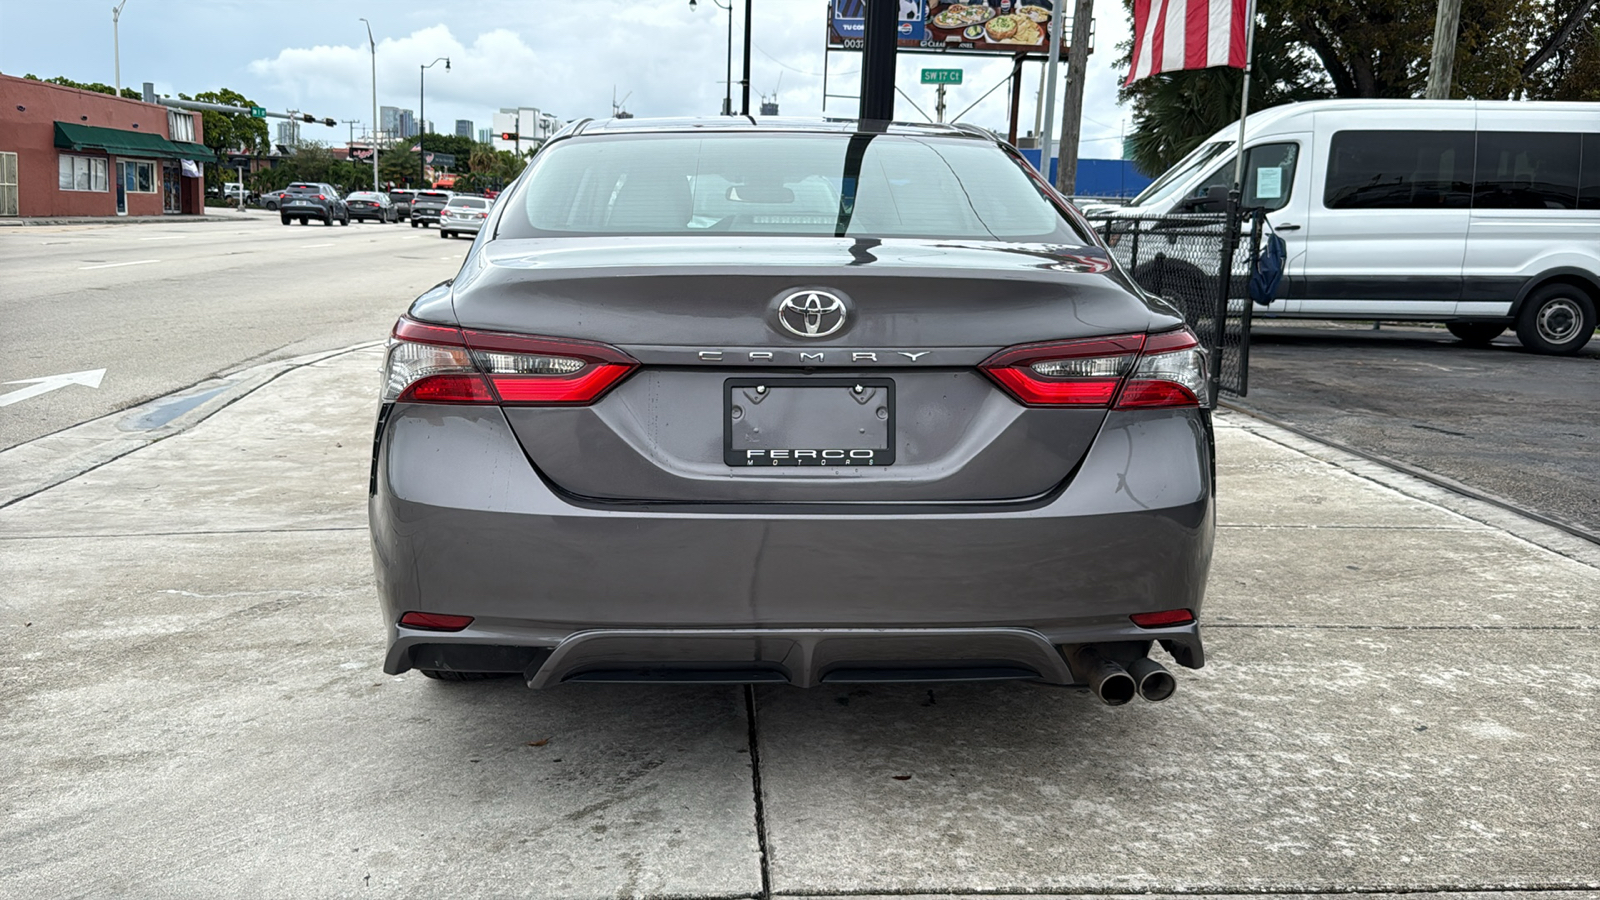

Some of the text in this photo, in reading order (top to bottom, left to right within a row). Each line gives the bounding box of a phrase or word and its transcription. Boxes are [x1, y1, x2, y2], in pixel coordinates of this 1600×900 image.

[925, 71, 960, 81] SW 17 Ct
[698, 351, 930, 362] CAMRY
[746, 449, 874, 459] FERCO
